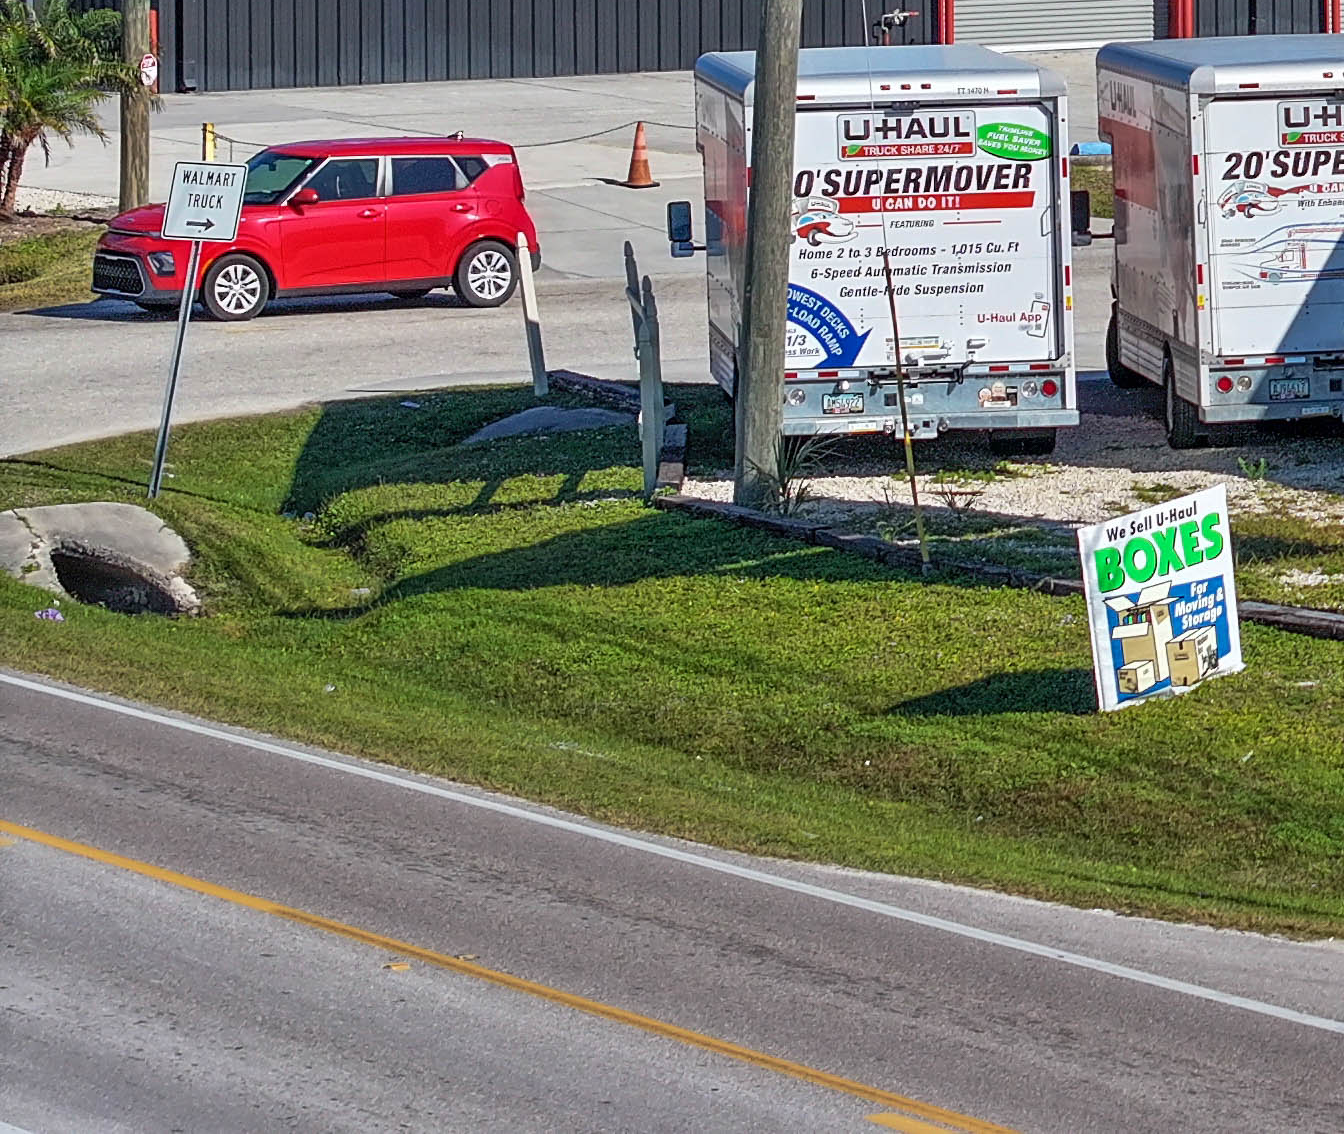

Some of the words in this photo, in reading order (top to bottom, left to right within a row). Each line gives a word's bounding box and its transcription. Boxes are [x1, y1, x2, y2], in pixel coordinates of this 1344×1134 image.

[843, 116, 970, 141] U-HAUL
[987, 131, 1009, 142] FUEL
[1303, 132, 1338, 143] TRUCK
[863, 145, 898, 156] TRUCK
[900, 144, 935, 155] SHARE
[937, 143, 960, 155] 24/7
[182, 169, 237, 187] WALMART
[793, 163, 1033, 199] 0'SUPERMOVER
[1309, 183, 1318, 193] U
[187, 193, 224, 210] TRUCK
[871, 198, 881, 210] U
[885, 197, 913, 210] CAN
[918, 197, 936, 210] DO
[941, 196, 960, 209] IT!
[1297, 198, 1316, 208] With
[889, 219, 935, 229] FEATURING
[799, 248, 833, 260] Home
[836, 247, 844, 259] 2
[848, 248, 860, 259] to
[864, 247, 872, 258] 3
[875, 246, 936, 257] Bedrooms
[951, 243, 982, 255] 1,015
[986, 243, 1005, 254] Cu.
[1007, 241, 1019, 253] Ft
[810, 267, 862, 280] 6-Speed
[864, 265, 928, 277] Autmatic
[932, 262, 1012, 275] Transmission
[913, 282, 985, 297] Suspension
[787, 288, 823, 311] OWEST
[820, 306, 850, 339] DECKS
[977, 312, 1016, 323] U-Haul
[1019, 312, 1042, 326] App
[786, 303, 821, 329] -LOAD
[817, 326, 843, 355] RAMP
[787, 334, 807, 346] 1/3
[1106, 527, 1126, 543] We
[1130, 515, 1153, 536] Sell
[1156, 500, 1198, 526] U-Haul
[1093, 512, 1224, 594] BOXES
[1190, 581, 1209, 598] For
[1174, 593, 1214, 617] Moving
[1216, 586, 1224, 602] &
[1181, 606, 1222, 630] Storage
